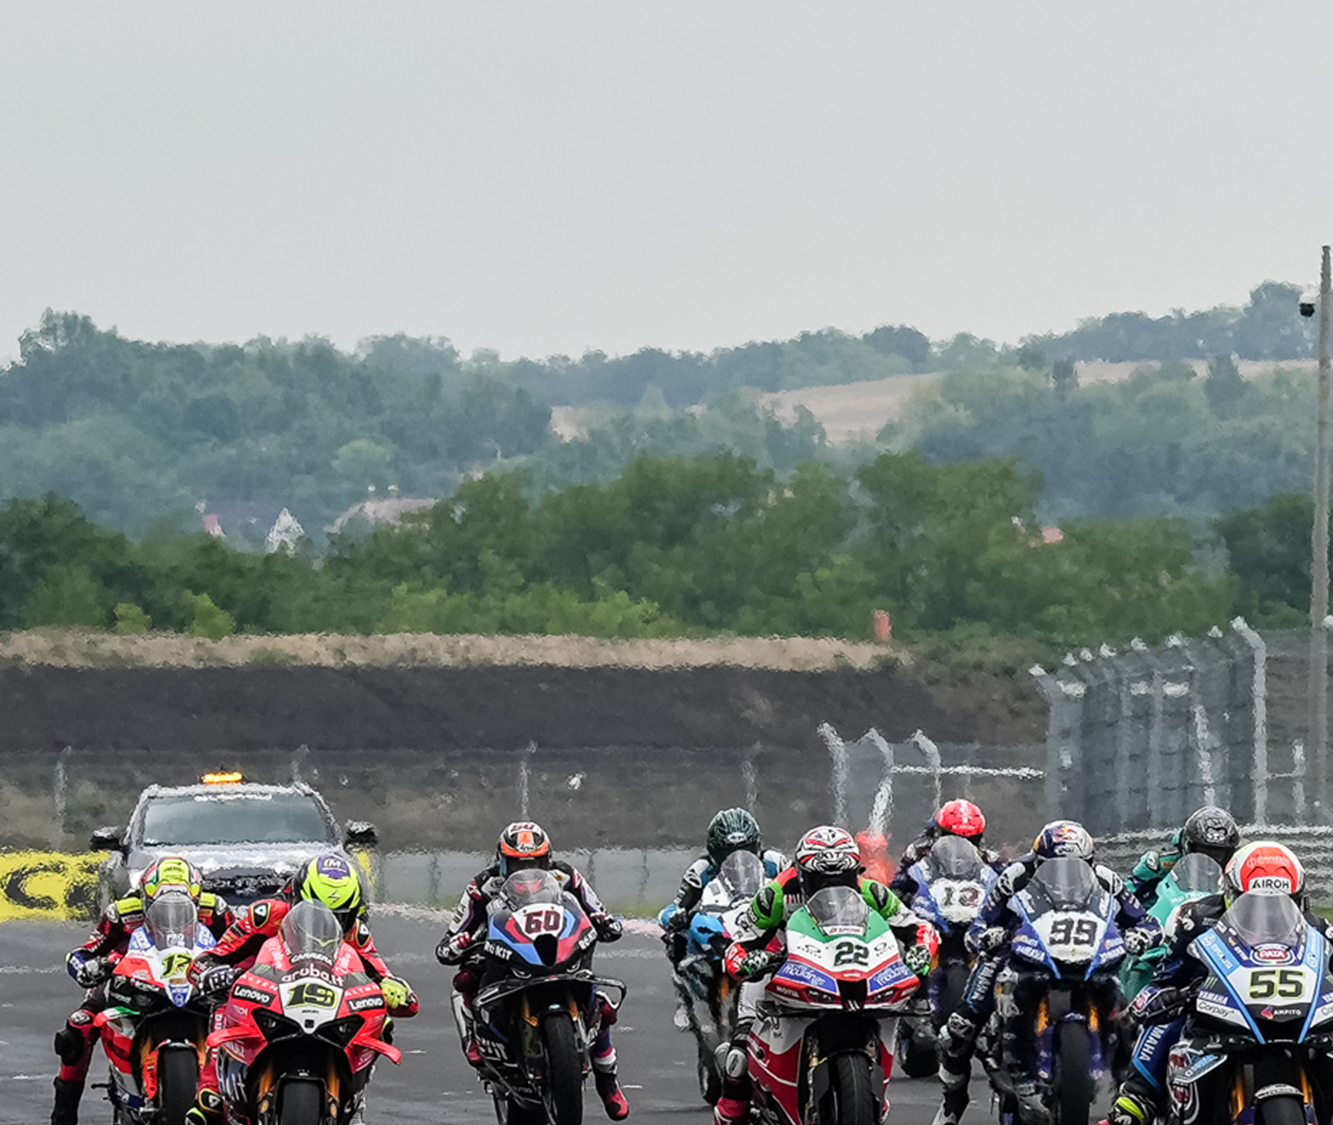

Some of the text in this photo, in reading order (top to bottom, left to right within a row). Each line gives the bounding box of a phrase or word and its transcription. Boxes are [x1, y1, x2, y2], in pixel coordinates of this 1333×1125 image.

[1252, 879, 1289, 889] AIROH
[523, 910, 560, 934] 60
[1050, 919, 1097, 947] 99
[291, 952, 333, 966] CARRERA
[834, 942, 869, 967] 22
[1259, 951, 1286, 959] PATA
[281, 964, 344, 986] aruba.it
[1249, 970, 1303, 999] 55
[234, 986, 270, 1003] Lenovo
[287, 983, 339, 1008] 19
[349, 997, 383, 1010] Lenovo
[1199, 990, 1228, 1005] YAMAHA
